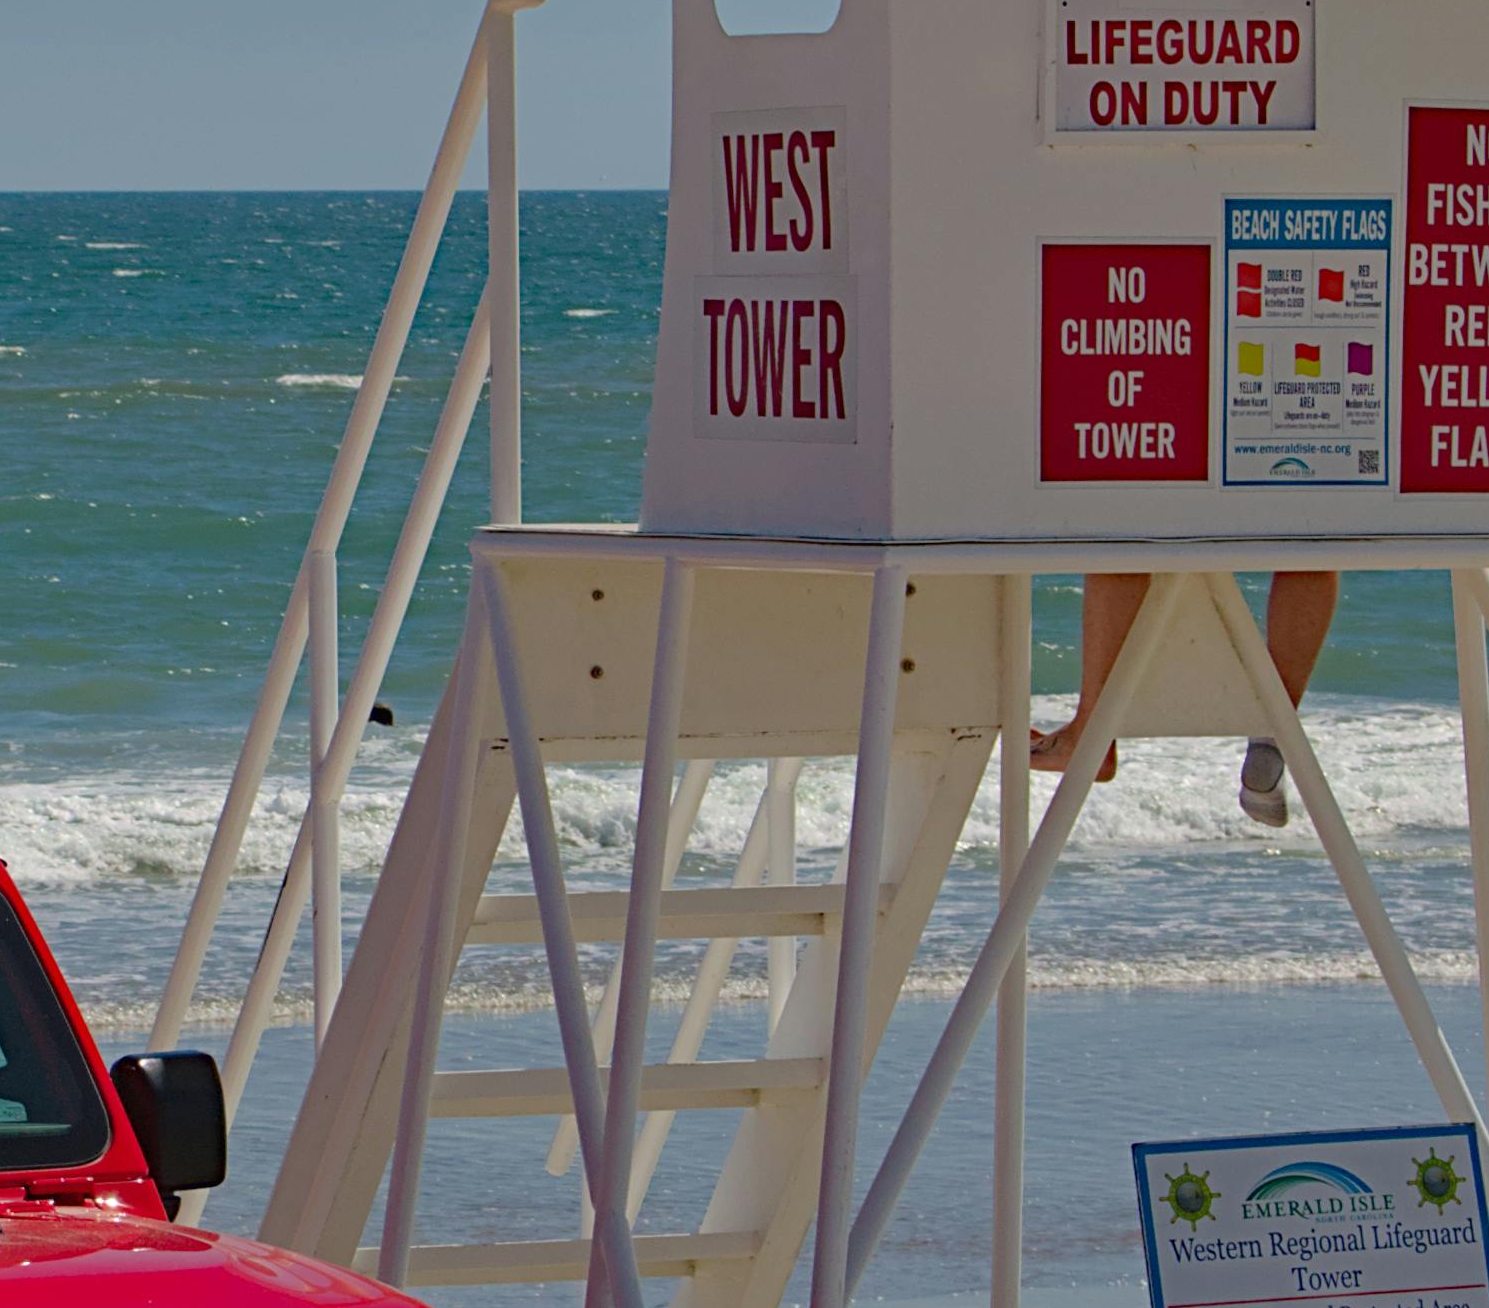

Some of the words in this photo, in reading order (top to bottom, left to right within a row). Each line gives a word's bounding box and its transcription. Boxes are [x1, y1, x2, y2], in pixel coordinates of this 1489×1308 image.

[1065, 20, 1301, 65] LIFEGUARD
[1088, 81, 1152, 125] ON
[1163, 80, 1277, 125] DUTY
[722, 129, 836, 253] WEST
[1232, 209, 1279, 240] BEACH
[1284, 209, 1338, 240] SAFETY
[1342, 209, 1386, 241] FLAGS
[1108, 266, 1146, 304] NO
[1291, 269, 1302, 282] RED
[1060, 318, 1192, 356] CLIMBING
[703, 299, 847, 420] TOWER
[1108, 369, 1143, 407] OF
[1239, 382, 1262, 394] YELLOW
[1274, 382, 1305, 394] LIFEGUARD
[1307, 382, 1341, 394] PROTECTED
[1299, 396, 1315, 408] AREA
[1351, 383, 1374, 395] PURPLE
[1074, 421, 1175, 459] TOWER
[1234, 444, 1352, 456] www.emeraldisle-nc.org
[1242, 1198, 1344, 1220] EMERALD
[1350, 1194, 1395, 1212] ISLE
[1169, 1237, 1263, 1263] Western
[1268, 1226, 1366, 1262] Regional
[1371, 1218, 1477, 1253] Lifeguard
[1291, 1266, 1363, 1291] Tower
